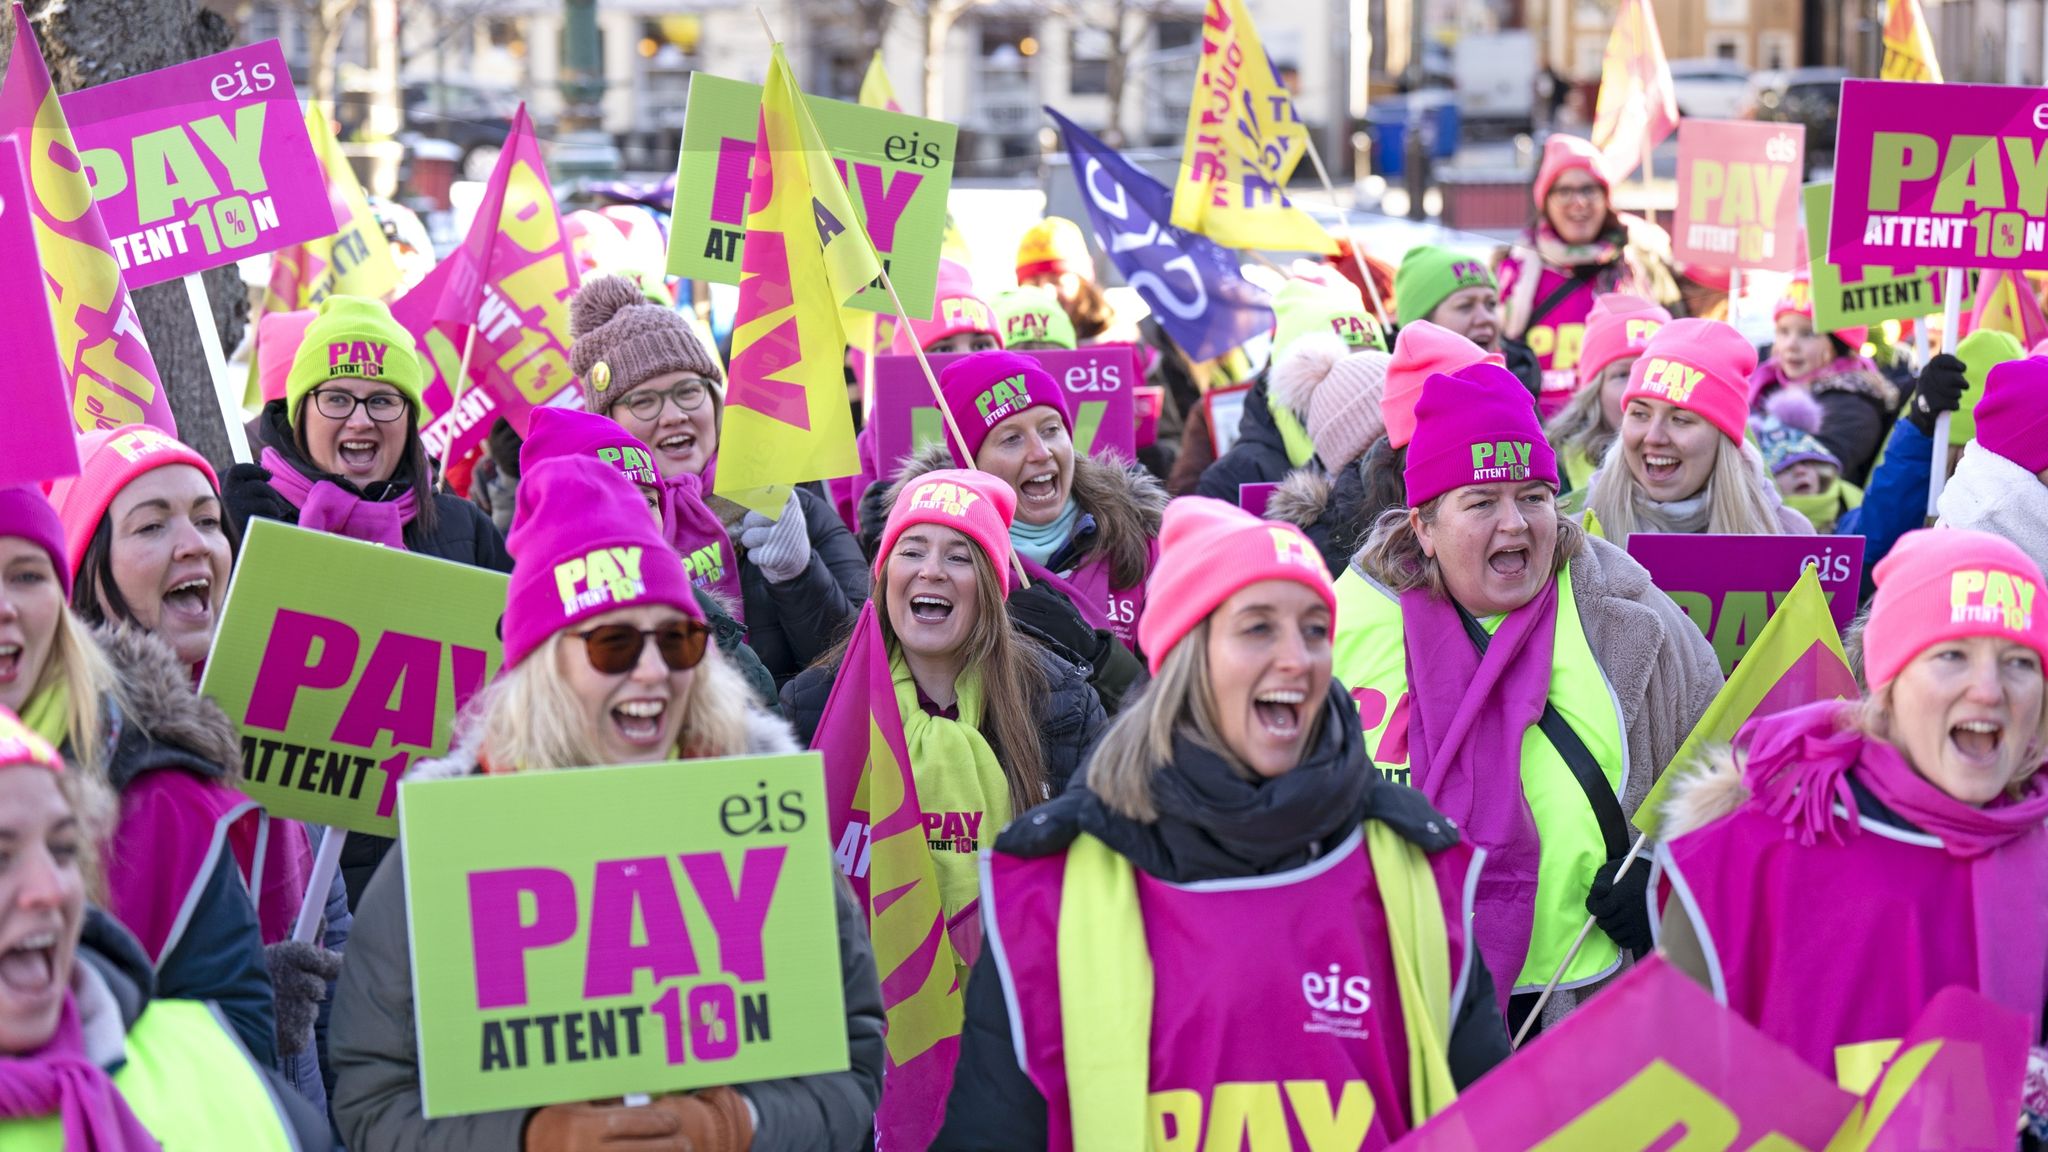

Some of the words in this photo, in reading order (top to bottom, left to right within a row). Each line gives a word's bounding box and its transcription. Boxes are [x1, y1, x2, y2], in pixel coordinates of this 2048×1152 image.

[211, 61, 276, 102] eis
[883, 131, 941, 169] eis
[710, 136, 924, 254] PY
[1690, 160, 1788, 229] PAY
[328, 340, 388, 367] PAY
[1526, 322, 1586, 371] PA
[974, 373, 1027, 418] PAY
[1065, 359, 1121, 393] eis
[1643, 358, 1706, 393] PAY
[1471, 441, 1532, 469] PAY
[911, 482, 980, 511] PAY
[554, 546, 644, 603] PAY
[1799, 547, 1851, 583] eis
[1105, 593, 1135, 624] is
[1950, 569, 2036, 614] PAY
[718, 780, 807, 837] eis
[921, 811, 984, 840] PAY
[466, 845, 789, 1011] PAY
[1302, 962, 1372, 1015] eis
[1147, 1079, 1376, 1152] PAY
